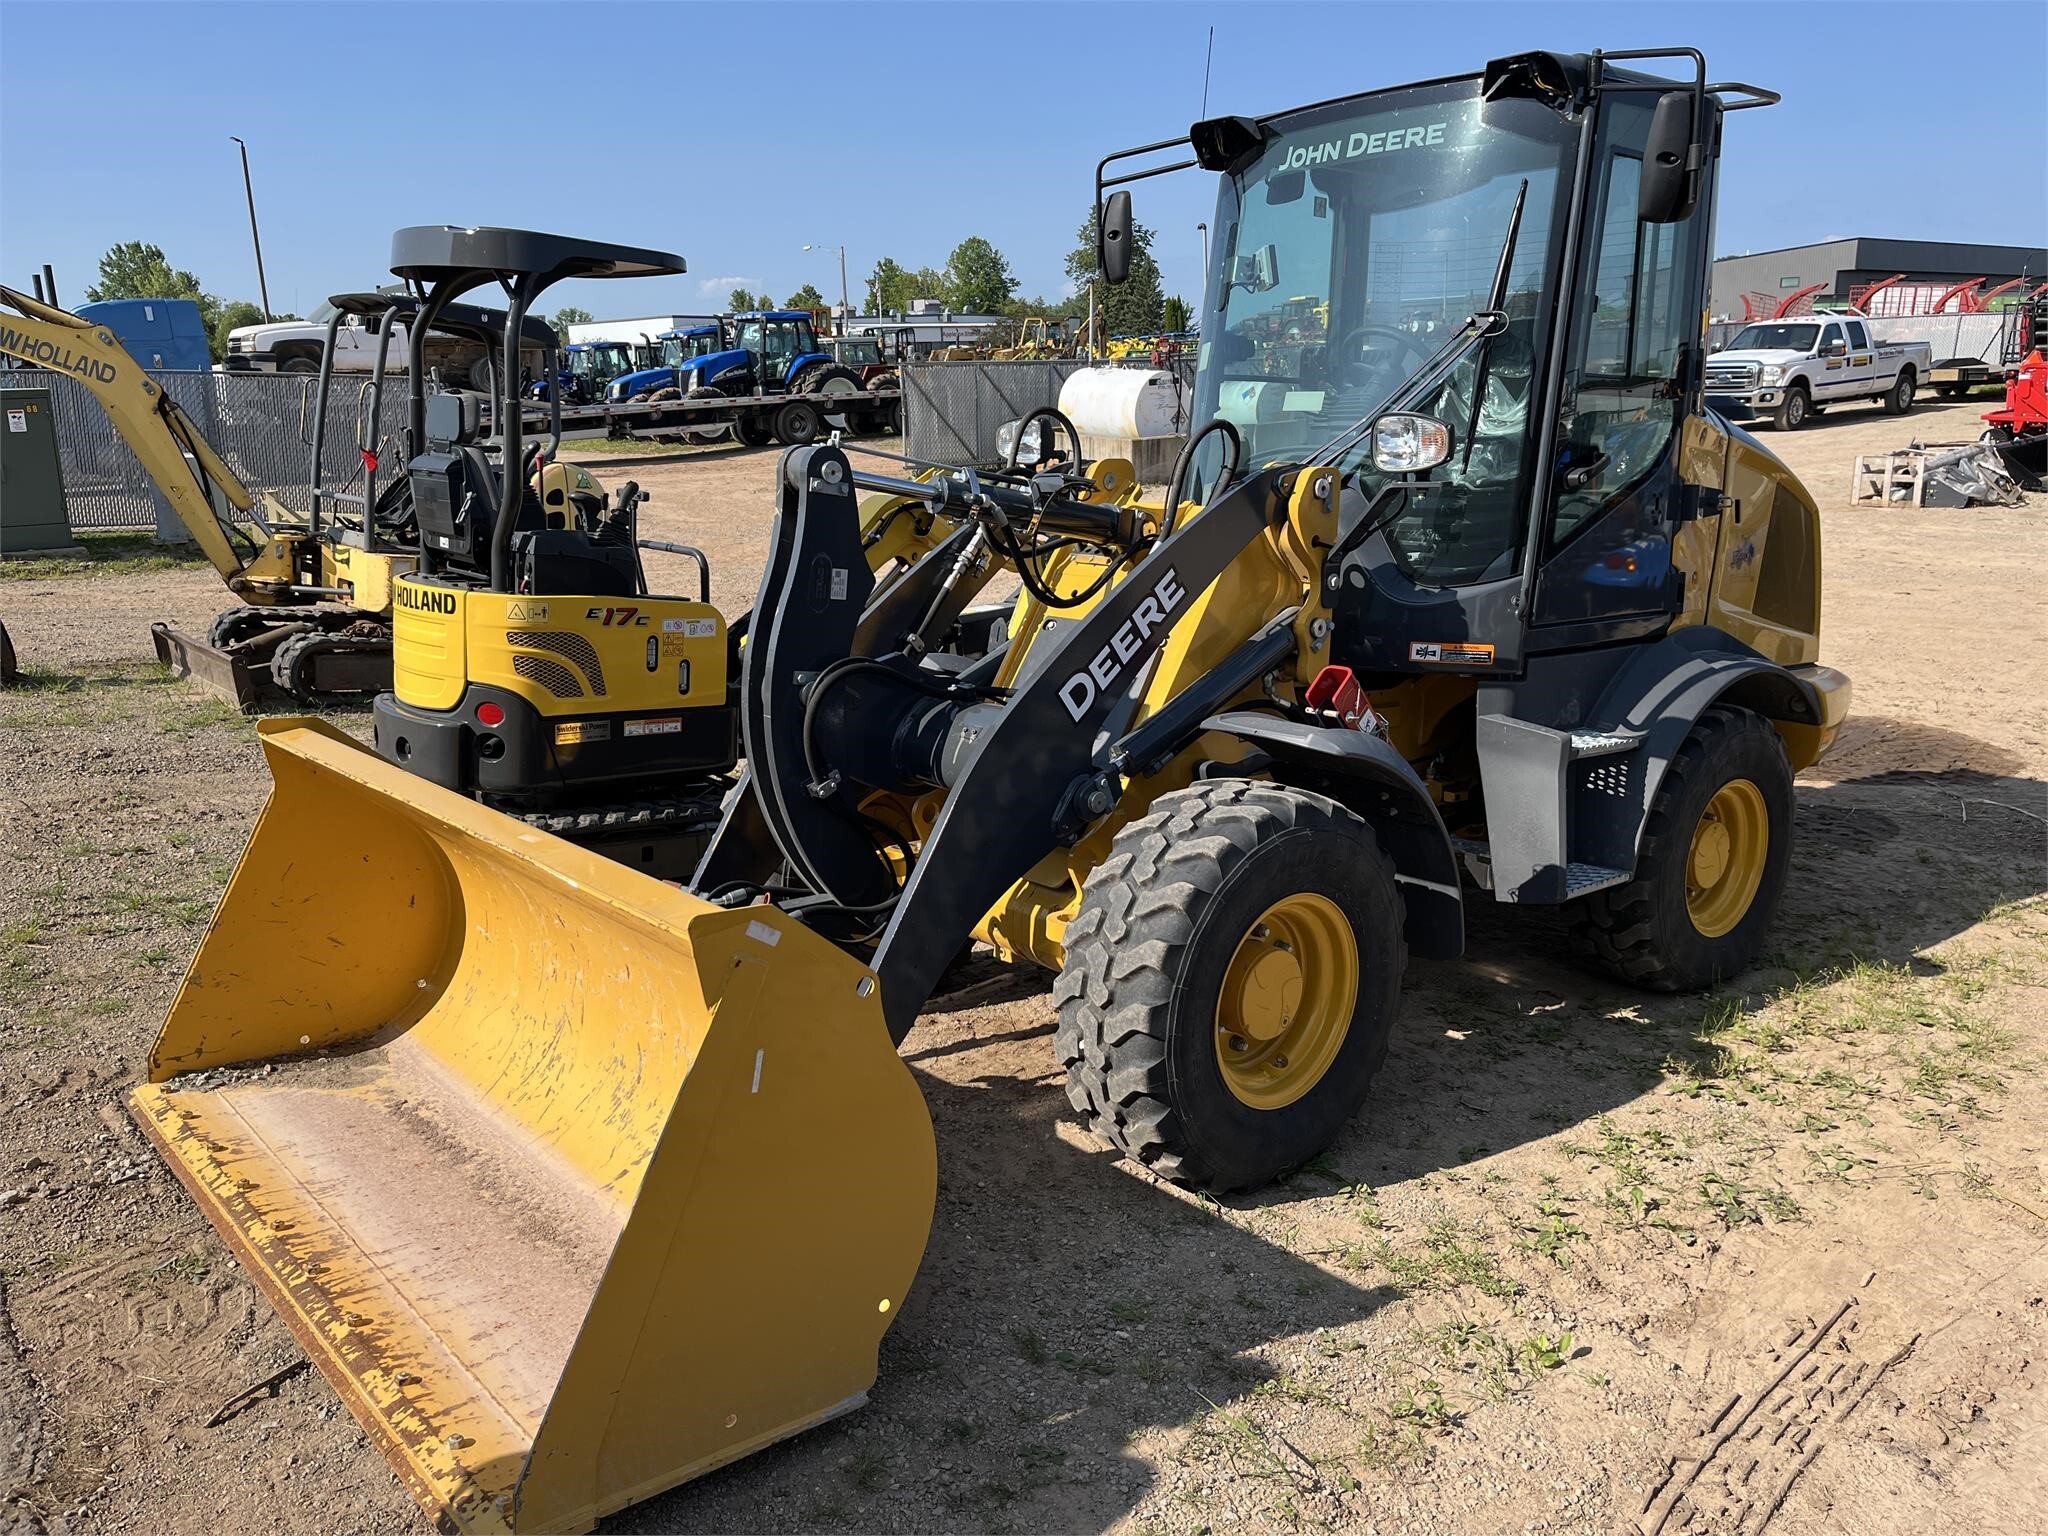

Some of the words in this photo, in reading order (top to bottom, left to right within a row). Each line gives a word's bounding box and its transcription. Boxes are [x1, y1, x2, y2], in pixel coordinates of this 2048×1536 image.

[1278, 139, 1342, 172] JOHN
[1346, 122, 1448, 158] DEERE
[21, 335, 117, 384] HOLLAND
[396, 585, 457, 615] HOLLAND
[1058, 567, 1187, 723] DEERE
